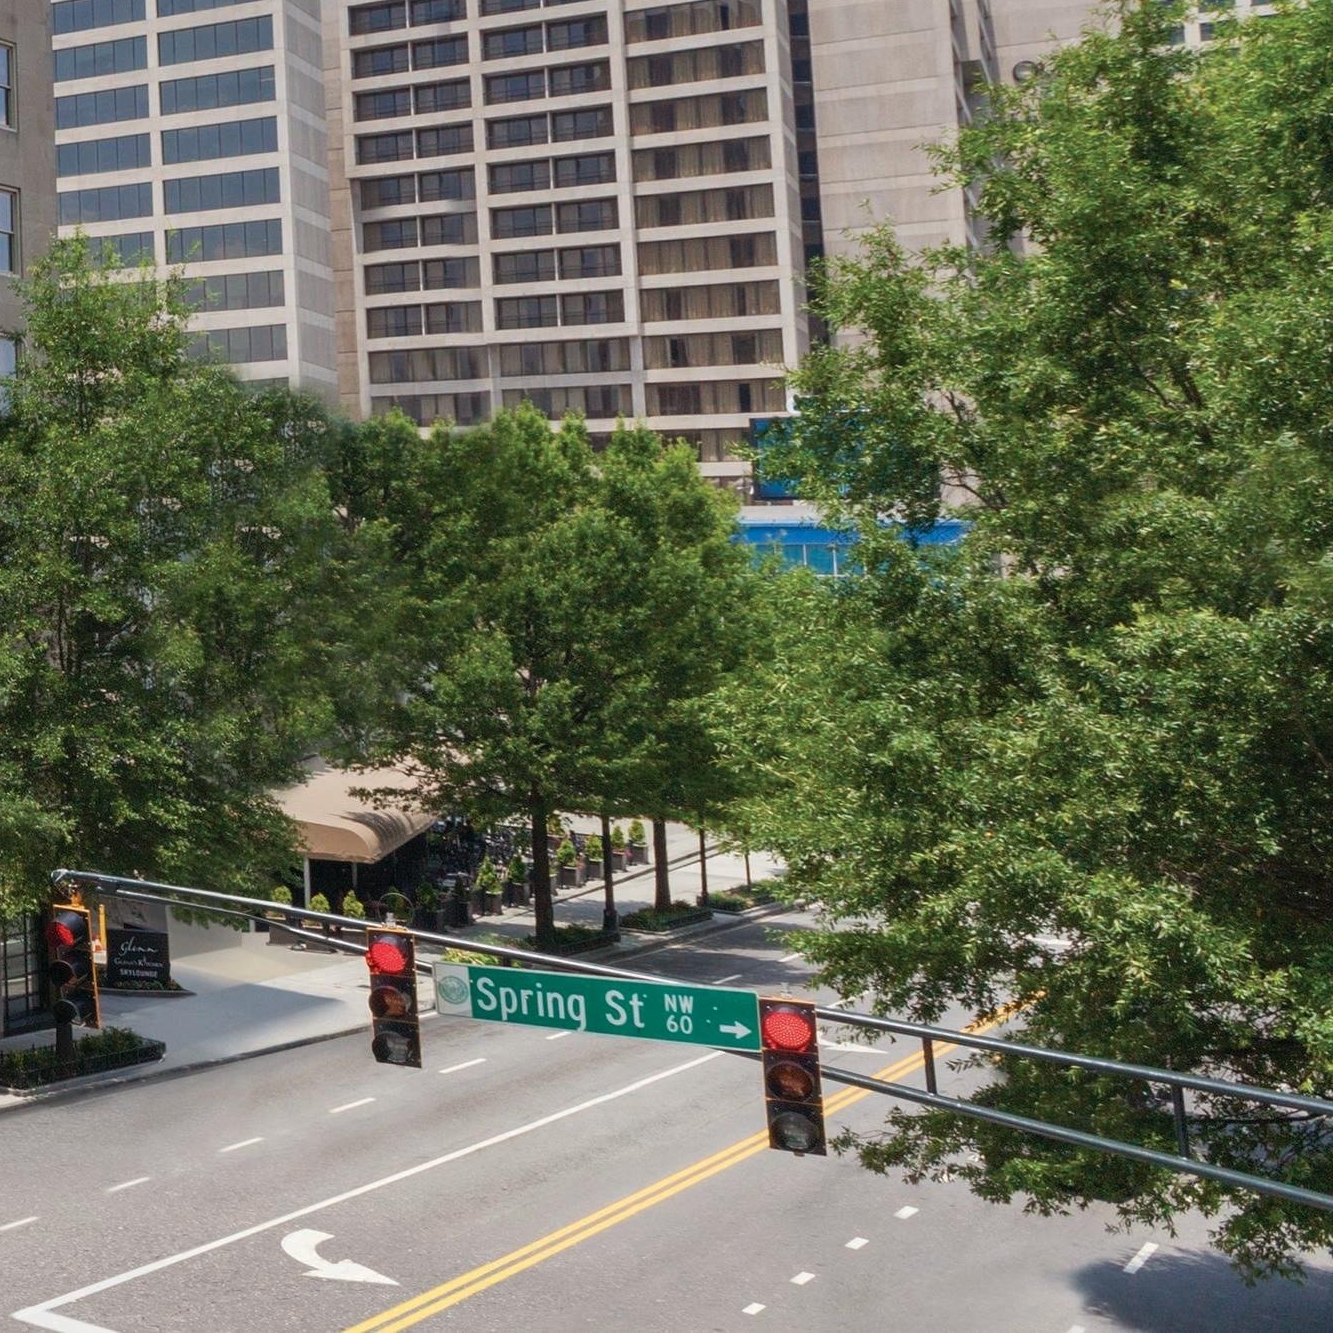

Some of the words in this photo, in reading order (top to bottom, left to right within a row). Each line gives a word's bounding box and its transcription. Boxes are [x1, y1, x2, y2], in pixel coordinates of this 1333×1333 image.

[476, 977, 587, 1031] Spring
[605, 990, 645, 1028] St
[664, 993, 694, 1014] NW
[666, 1015, 693, 1035] 60
